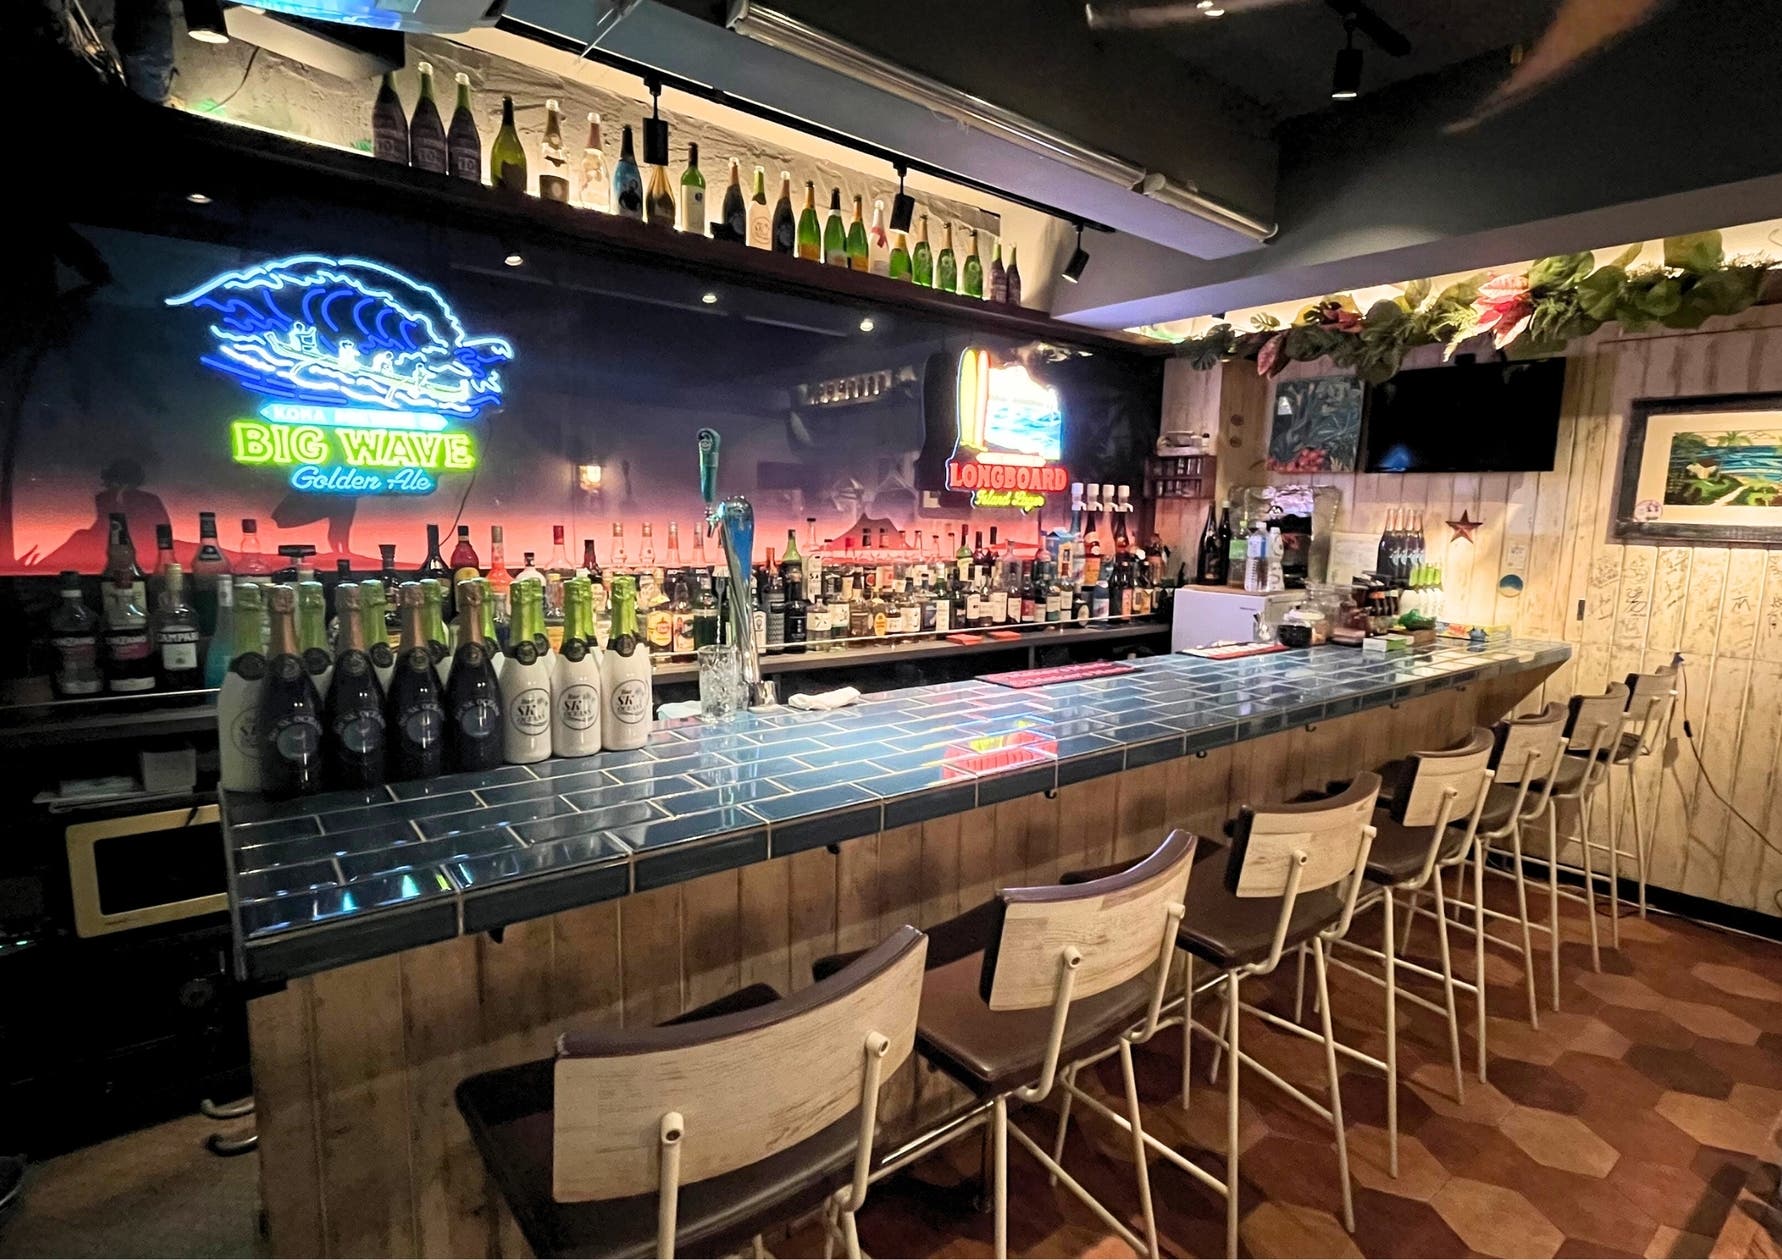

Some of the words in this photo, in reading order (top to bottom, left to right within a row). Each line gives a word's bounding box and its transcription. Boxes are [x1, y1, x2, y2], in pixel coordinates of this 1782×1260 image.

[233, 421, 329, 464] BIG
[338, 429, 475, 467] WAVE
[291, 465, 383, 491] Golden
[387, 466, 432, 491] Ale
[950, 464, 1068, 491] LONGBOARD
[974, 489, 1013, 505] Island
